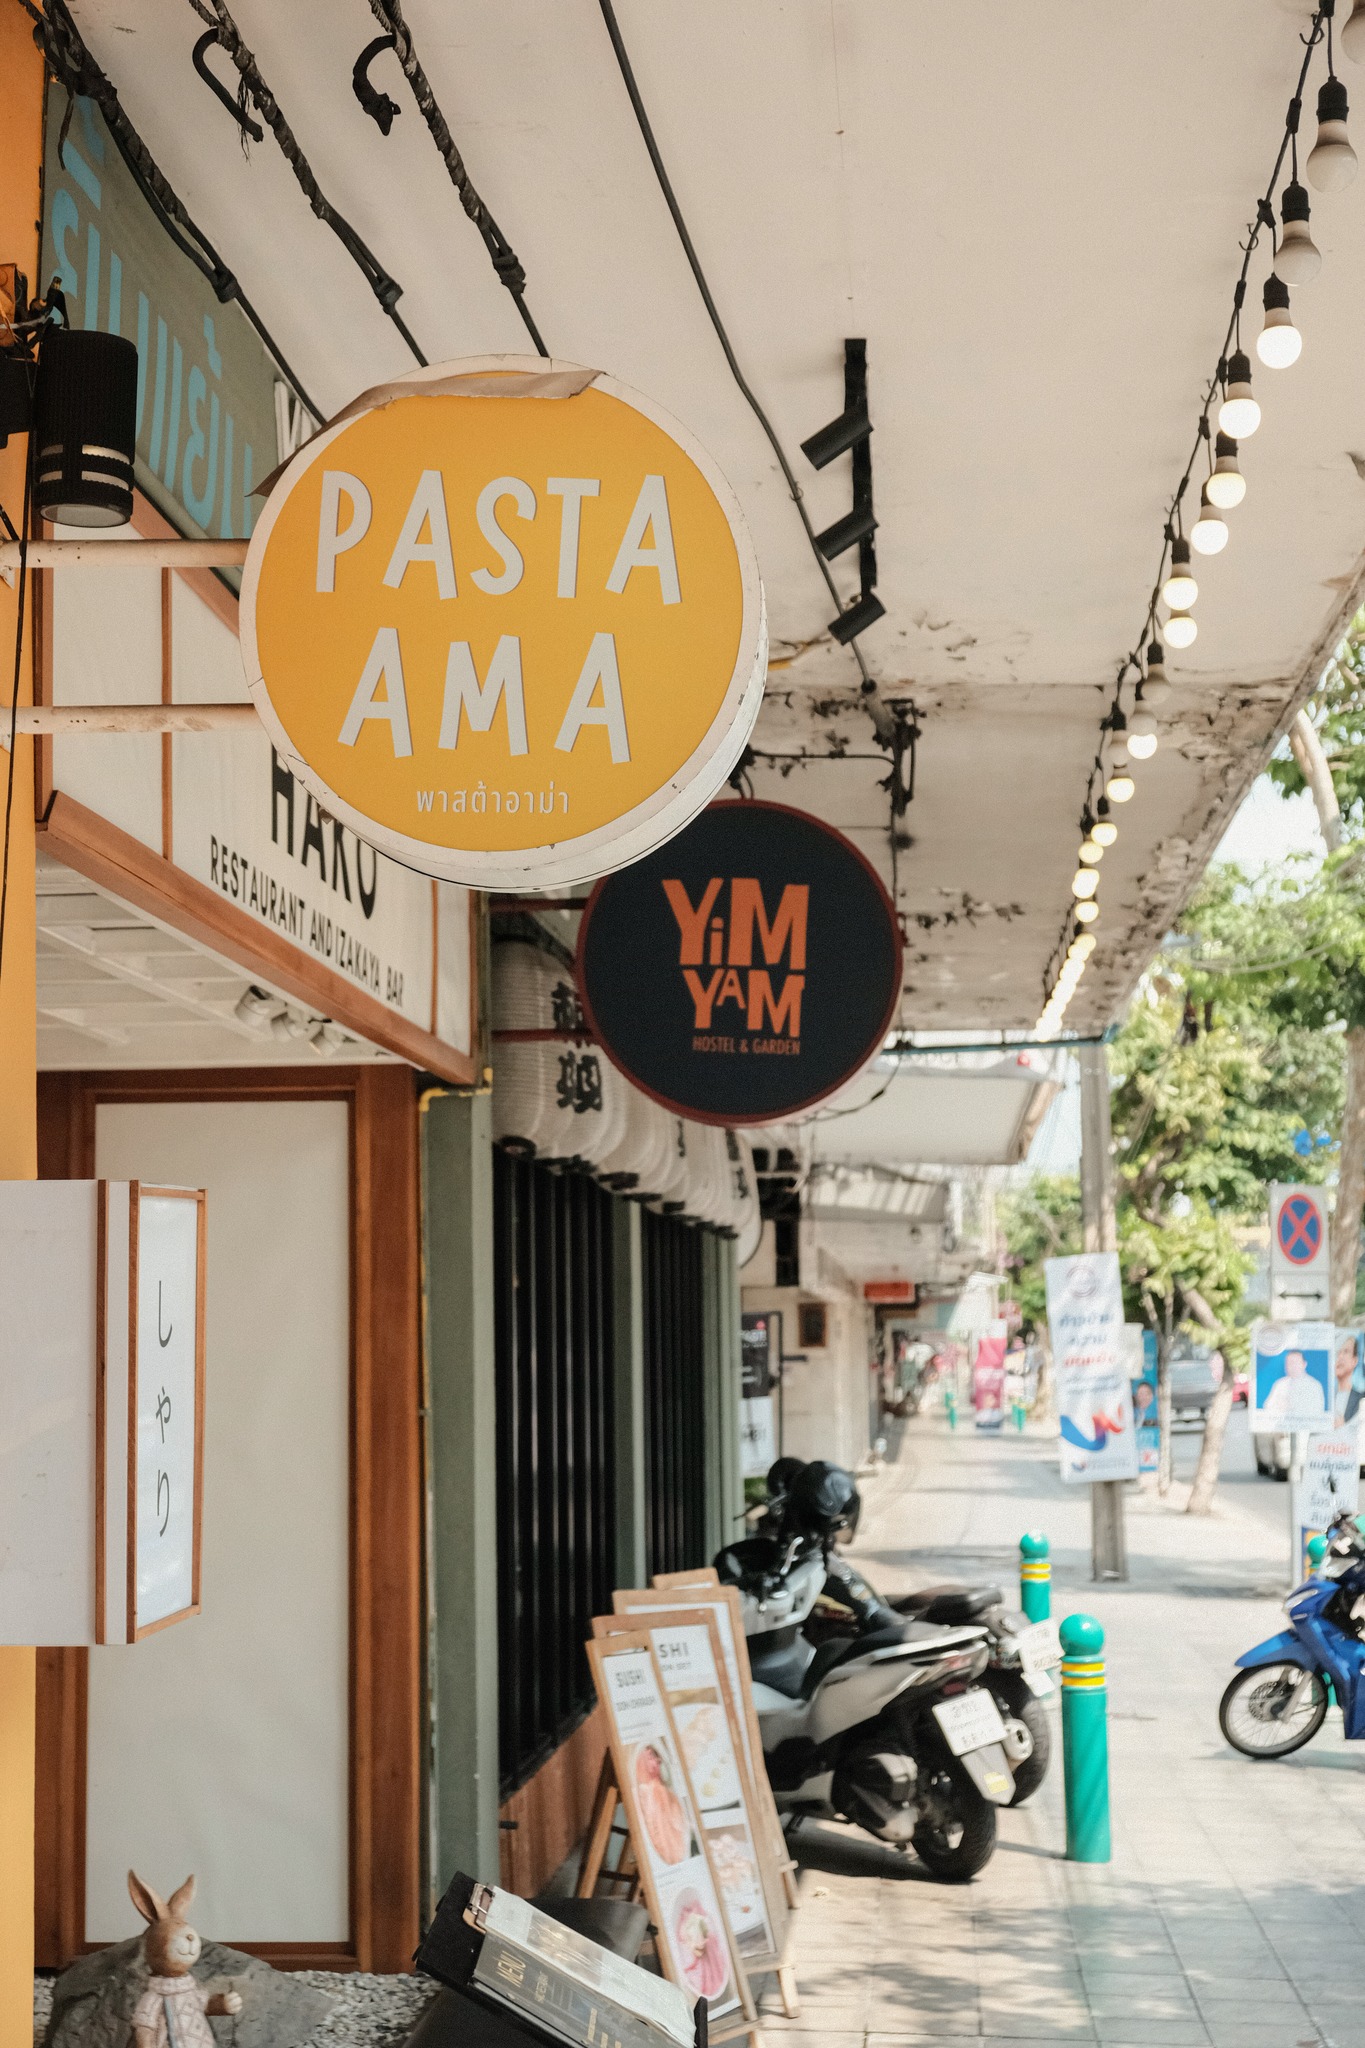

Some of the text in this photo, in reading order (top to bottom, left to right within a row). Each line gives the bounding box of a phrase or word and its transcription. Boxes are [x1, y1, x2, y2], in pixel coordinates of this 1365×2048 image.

[316, 470, 682, 605] PASTA
[338, 627, 631, 764] AMA
[416, 781, 569, 814] พาสต้าอาม่า
[211, 834, 404, 1006] RESTAURANT AND IZAKAYA BAR
[683, 969, 805, 1038] YAM
[692, 1036, 800, 1055] HOSTEL & GARDEN
[658, 1642, 690, 1658] SHI
[496, 1950, 526, 1988] MENU
